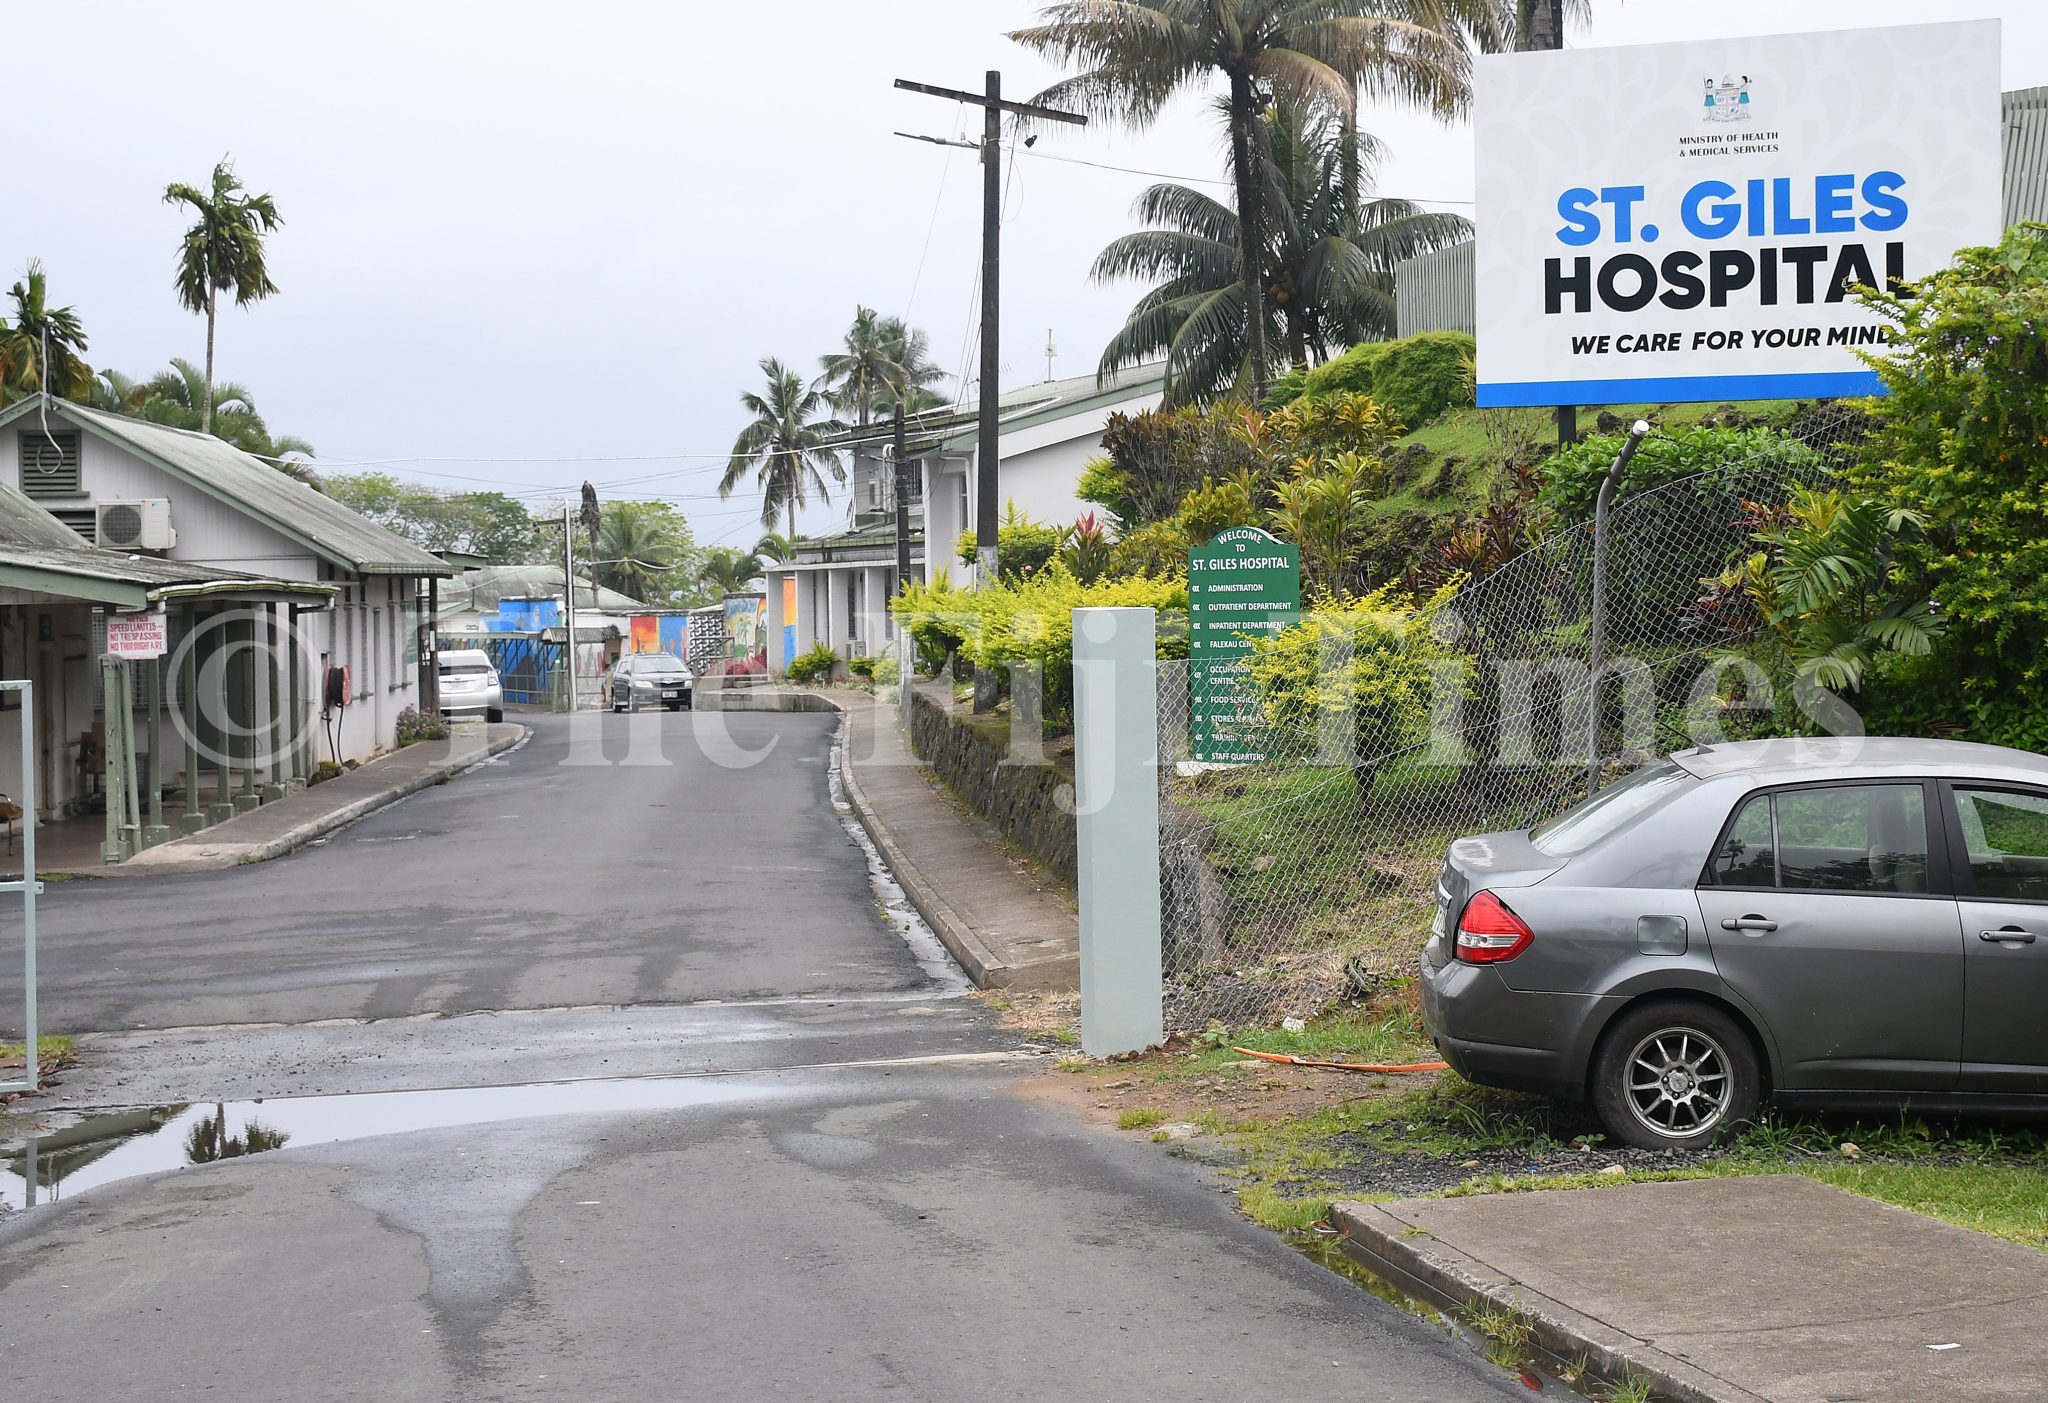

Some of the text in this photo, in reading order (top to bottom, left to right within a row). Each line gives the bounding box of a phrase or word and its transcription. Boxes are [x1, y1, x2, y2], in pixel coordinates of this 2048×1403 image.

[1679, 131, 1779, 145] MINISTRY OF HEALTH
[1679, 144, 1779, 157] & MEDICAL SERVICES
[1555, 171, 1909, 246] ST. GILES
[1544, 241, 1920, 314] HOSPITAL
[1571, 335, 1610, 355] WE
[1615, 332, 1682, 354] CARE
[1691, 330, 1745, 351] FOR
[1751, 327, 1820, 349] YOUR
[1217, 529, 1263, 545] WELCOME
[1235, 544, 1246, 552] TO
[1192, 557, 1290, 571] ST. GILES HOSPITAL
[1208, 584, 1264, 592] ADMINISTRATION
[1208, 602, 1292, 611] OUTPATIENT DEPARTMENT
[110, 623, 129, 632] SPEED
[1209, 621, 1286, 630] INPATIENT DEPARTMENT
[110, 632, 162, 641] NO TRESPASSING
[110, 643, 119, 651] NO
[1211, 696, 1229, 704] FOOD
[1231, 753, 1265, 761] QUARTERS
